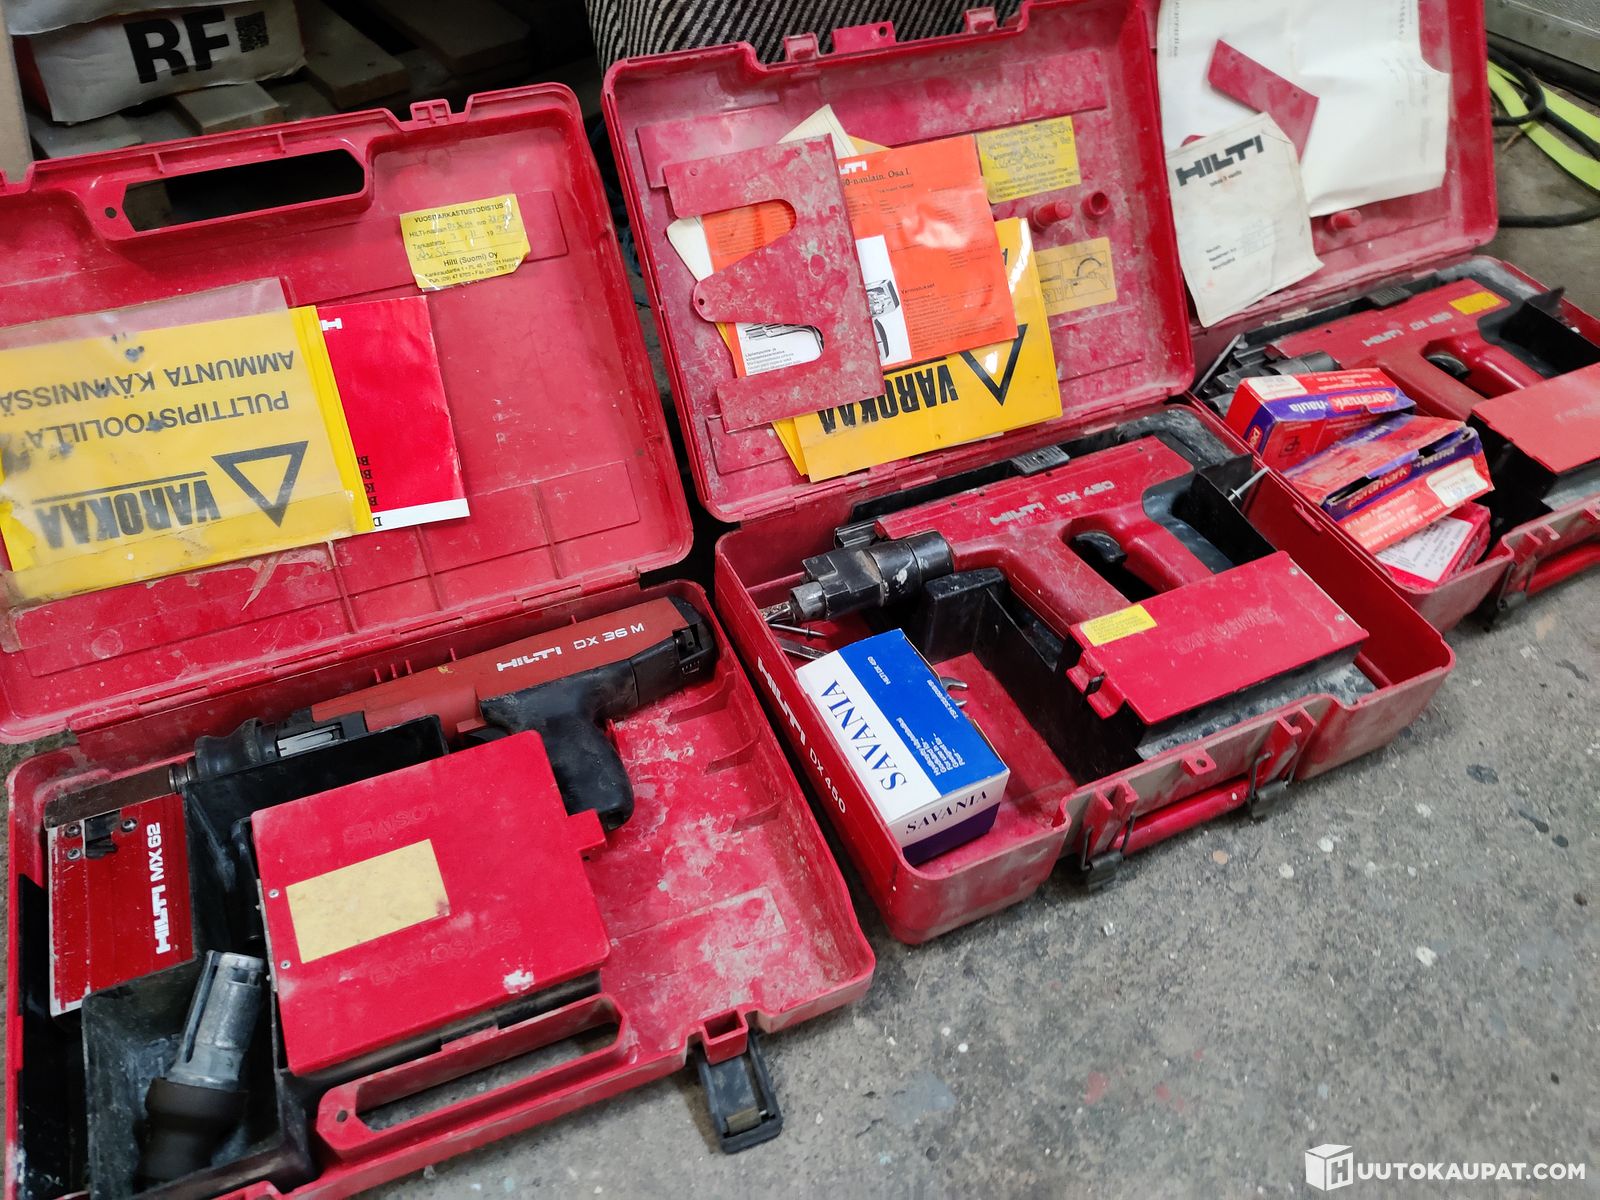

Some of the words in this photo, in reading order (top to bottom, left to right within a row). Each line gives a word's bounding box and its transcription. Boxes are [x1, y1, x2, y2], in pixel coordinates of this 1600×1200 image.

[123, 6, 230, 84] RF
[839, 160, 867, 174] LTI
[1175, 135, 1264, 186] HILTI
[443, 258, 458, 267] Hilti
[488, 251, 498, 260] Oy
[1362, 329, 1404, 347] HILTI
[164, 350, 294, 387] AMMUNTA
[0, 371, 155, 417] KÄYNNISSÄ
[26, 390, 290, 450] PULTTIPISTOOLILLA
[36, 479, 222, 550] VAROKAA
[990, 502, 1046, 525] HILTI
[1056, 491, 1081, 504] DX
[496, 646, 562, 671] HILTI
[573, 635, 599, 650] DX
[602, 627, 628, 642] 36
[630, 622, 645, 634] M
[757, 656, 806, 746] HILTI
[809, 747, 824, 776] DX
[821, 679, 908, 790] SAVANIA
[905, 790, 988, 835] SAVANIA
[151, 884, 171, 954] HILTI
